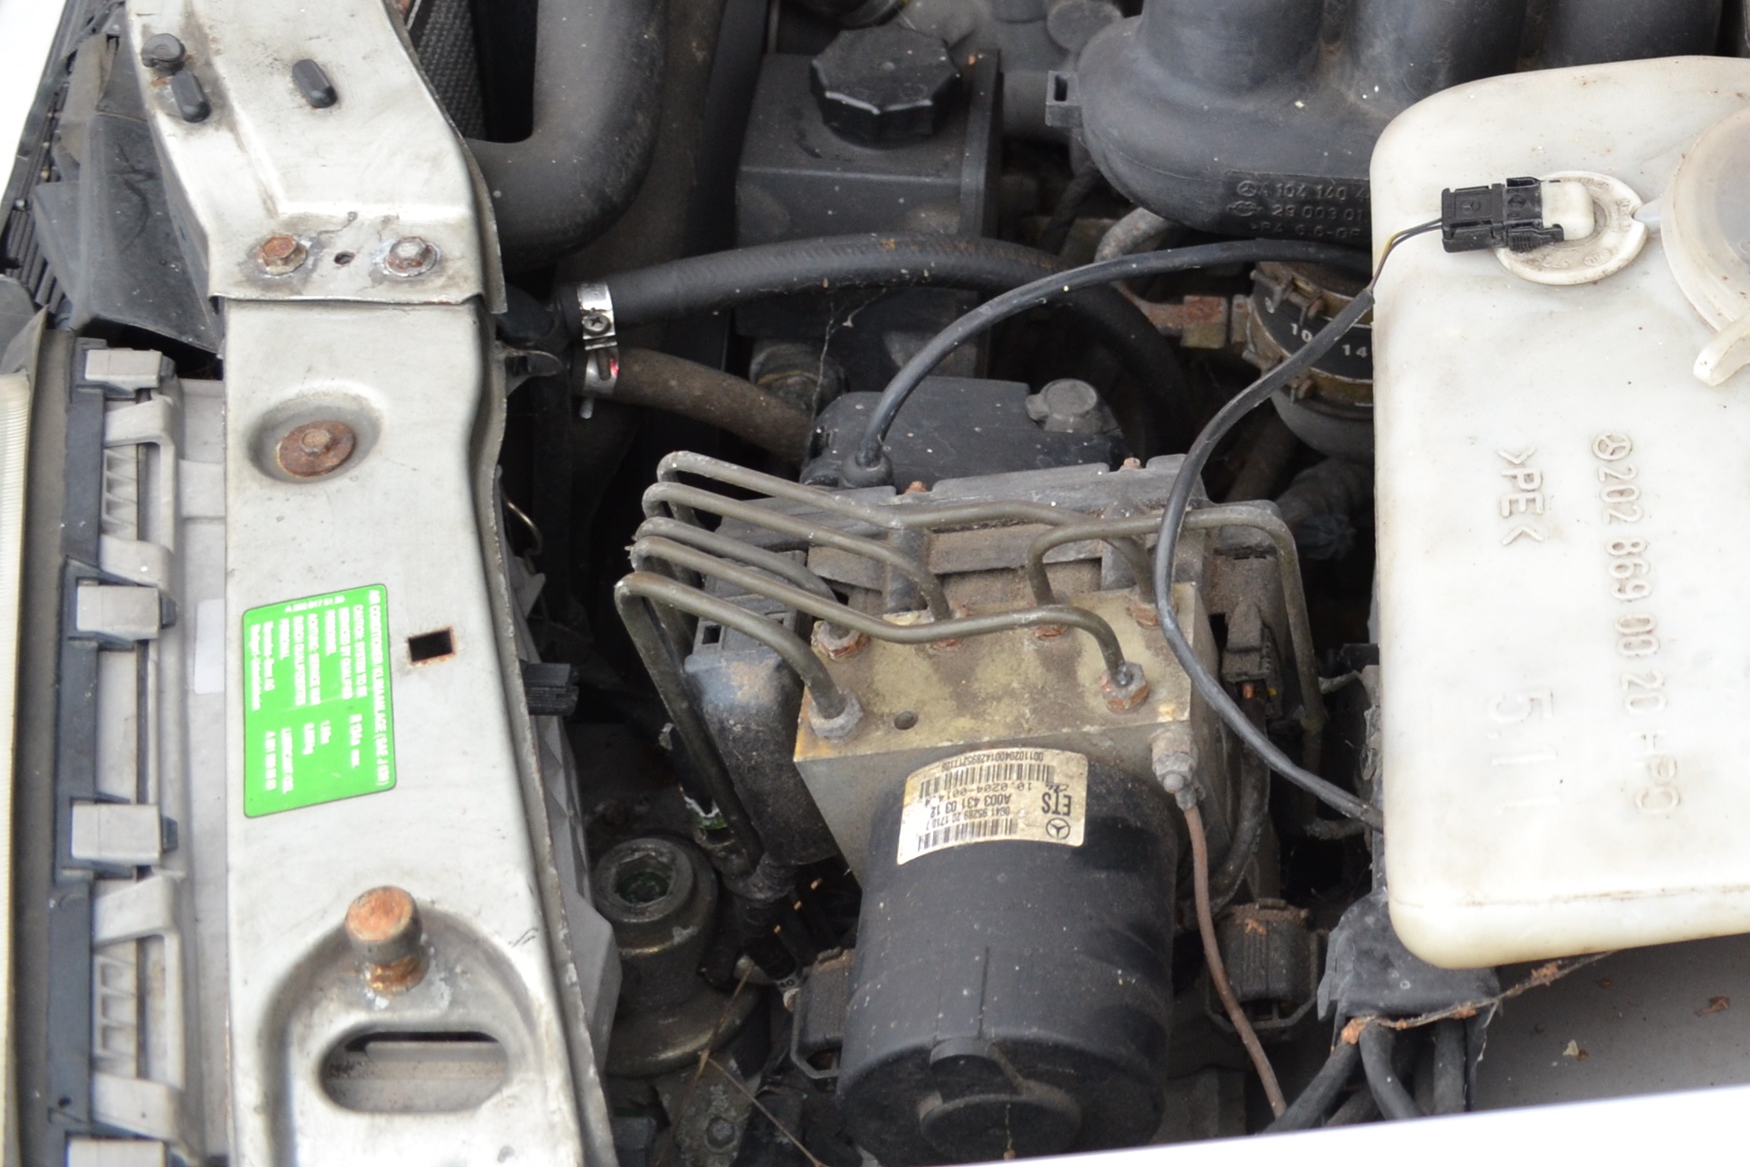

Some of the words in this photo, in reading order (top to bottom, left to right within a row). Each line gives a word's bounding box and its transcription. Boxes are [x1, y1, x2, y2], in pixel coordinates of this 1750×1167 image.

[1276, 183, 1306, 199] 104
[1315, 184, 1347, 201] 140
[1290, 322, 1313, 343] 10
[1341, 343, 1368, 359] 14
[1597, 463, 1645, 524] 202
[1605, 537, 1654, 603] 869
[1612, 613, 1661, 657] 00
[1619, 668, 1668, 715] 20
[945, 800, 957, 814] 03
[961, 796, 980, 812] 431
[984, 792, 1012, 808] A003
[1041, 791, 1073, 817] ETS
